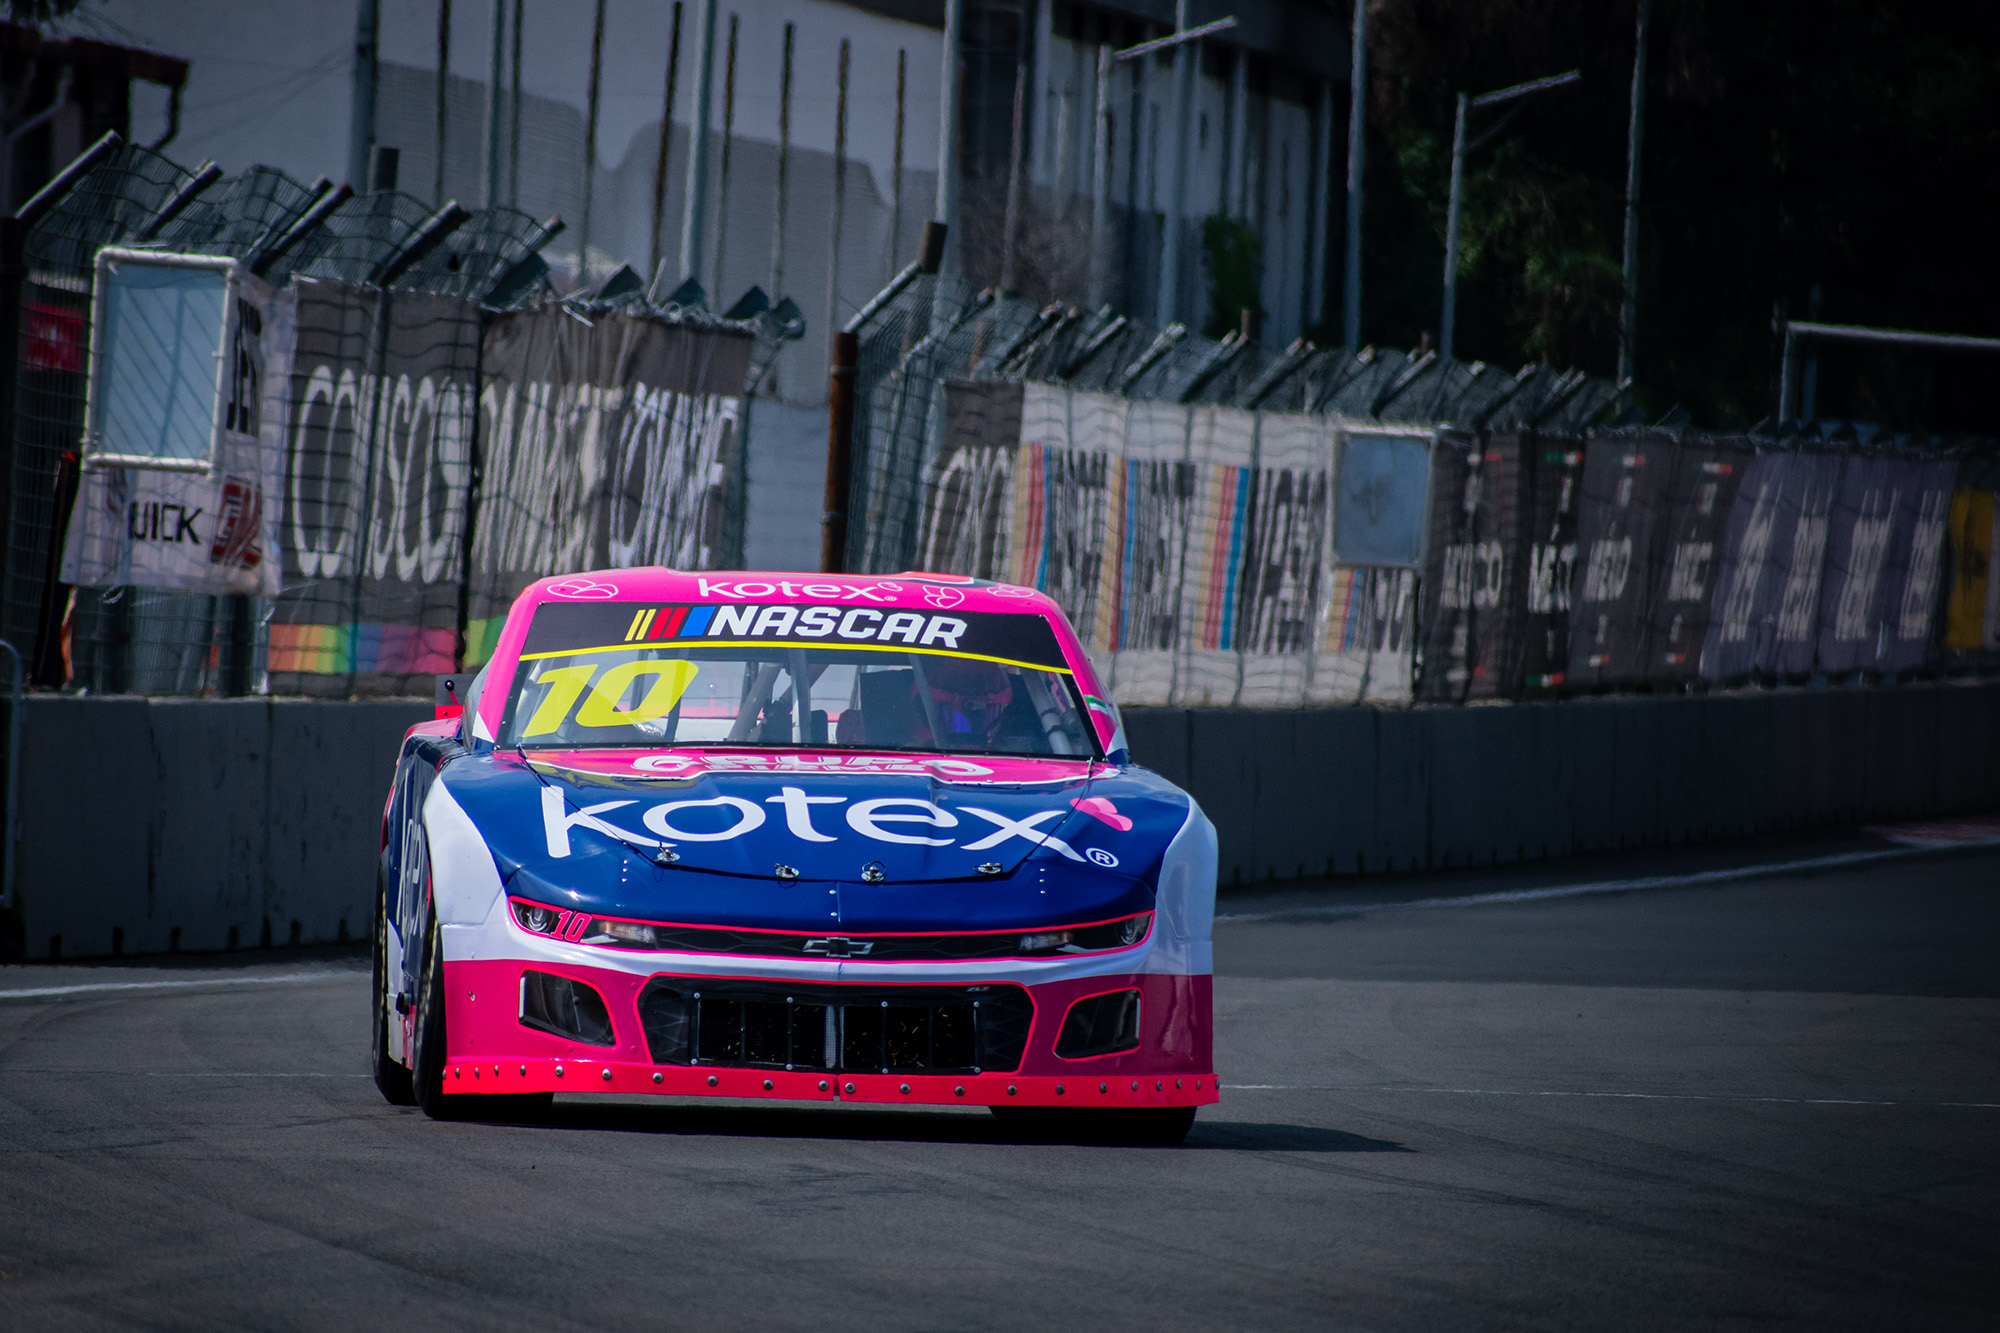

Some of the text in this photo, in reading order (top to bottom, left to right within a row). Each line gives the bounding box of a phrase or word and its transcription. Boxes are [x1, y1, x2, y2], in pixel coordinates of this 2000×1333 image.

[707, 605, 968, 649] NASCAR
[521, 659, 699, 738] 10
[550, 910, 592, 943] 10
